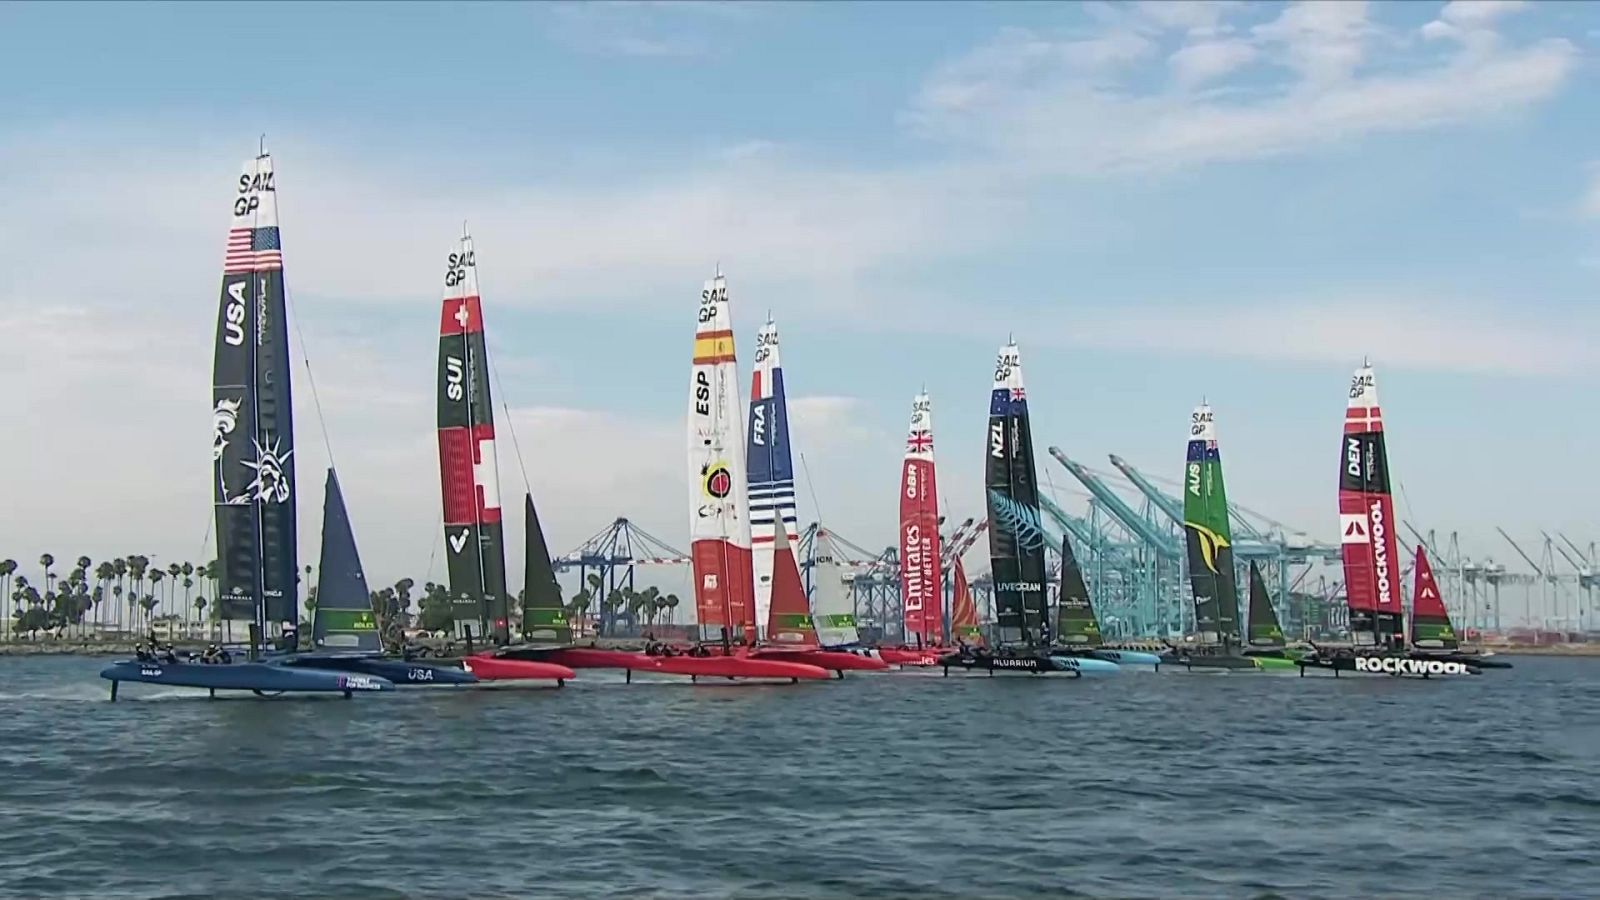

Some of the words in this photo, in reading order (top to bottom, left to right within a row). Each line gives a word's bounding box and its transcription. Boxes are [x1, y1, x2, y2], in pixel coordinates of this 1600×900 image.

[238, 172, 276, 193] SAIL
[234, 197, 259, 216] GP
[445, 270, 466, 286] GP
[701, 288, 728, 304] SAIL
[225, 281, 246, 346] USA
[698, 306, 717, 323] GP
[757, 332, 778, 346] SAIL
[755, 348, 770, 362] GP
[447, 356, 463, 402] SUI
[994, 368, 1011, 381] GP
[696, 371, 709, 416] ESP
[1349, 387, 1364, 398] GP
[753, 404, 765, 446] FRA
[1191, 425, 1206, 435] GP
[991, 421, 1004, 459] NZL
[1348, 438, 1360, 477] DEN
[907, 464, 917, 499] GBR
[1189, 464, 1200, 496] AUS
[922, 537, 932, 576] BETTER
[1370, 500, 1391, 604] ROCKWOOL
[904, 525, 923, 612] Emirates
[408, 669, 433, 680] USA
[1355, 657, 1470, 675] ROCKWOOL
